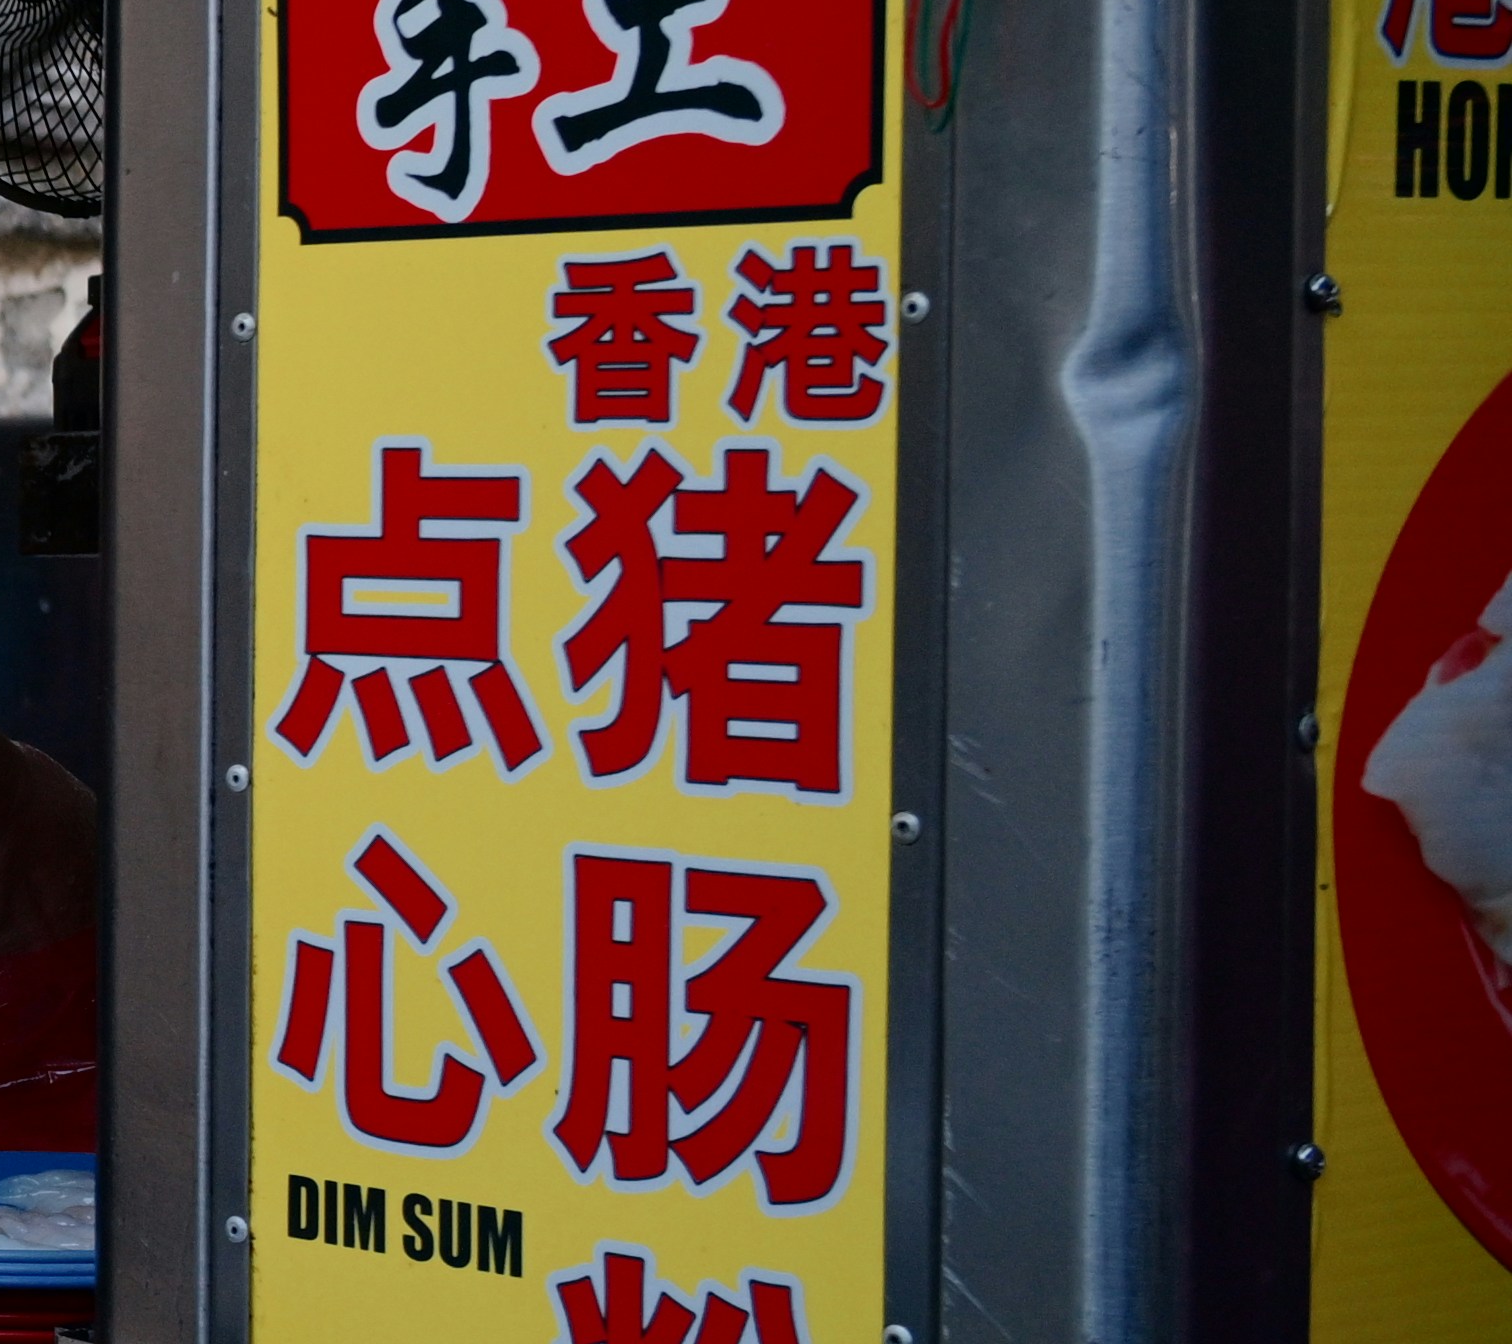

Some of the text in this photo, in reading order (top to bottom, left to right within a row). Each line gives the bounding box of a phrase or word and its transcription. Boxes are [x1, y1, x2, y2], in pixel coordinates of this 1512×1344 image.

[549, 244, 889, 424] 香港
[275, 446, 544, 1149] 点心
[287, 1174, 524, 1278] DIM SUM
